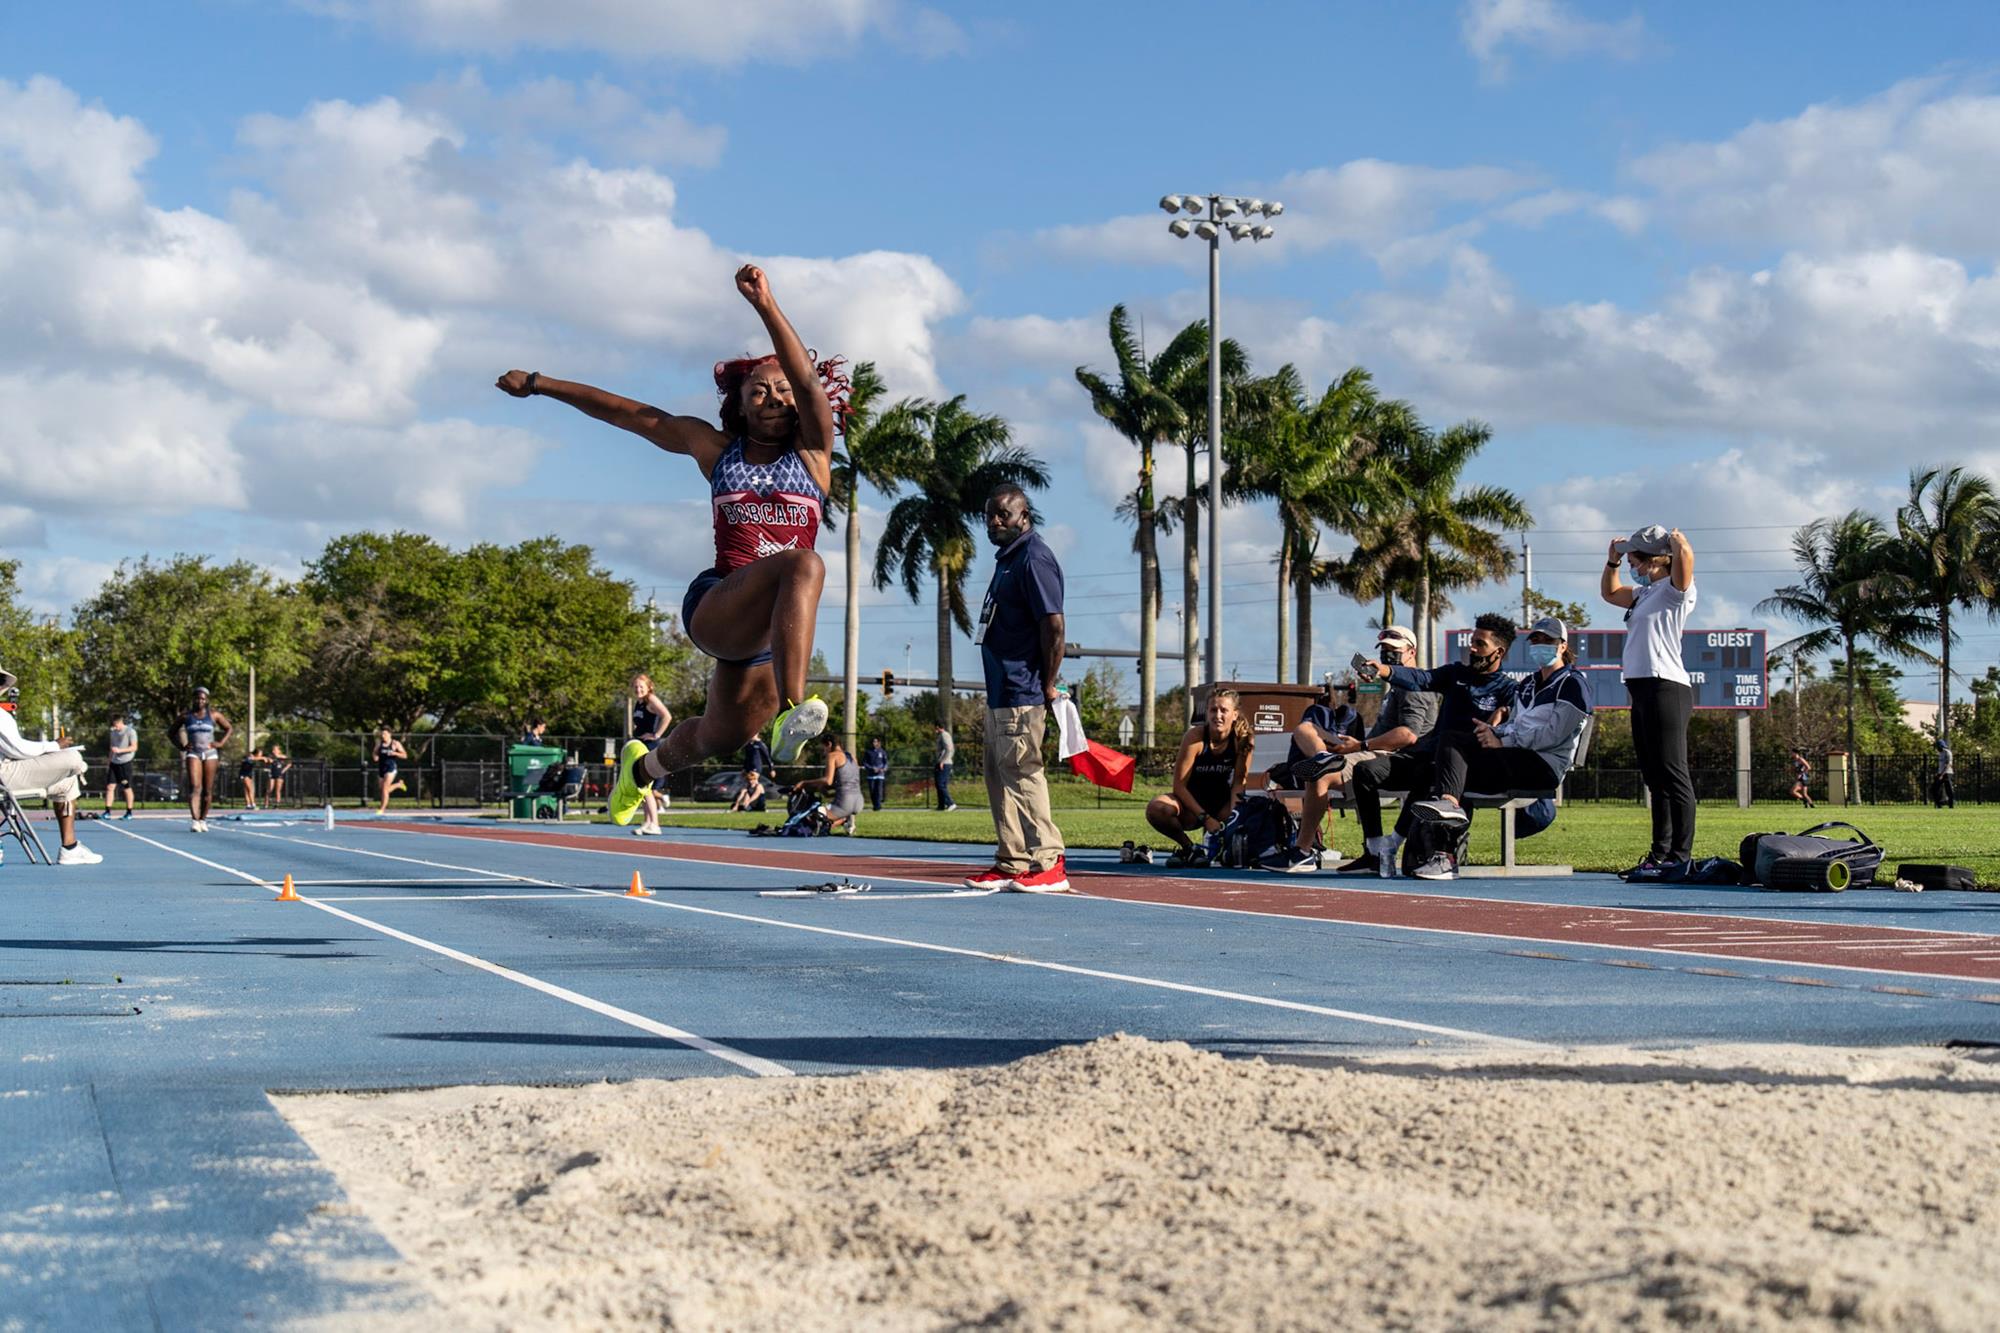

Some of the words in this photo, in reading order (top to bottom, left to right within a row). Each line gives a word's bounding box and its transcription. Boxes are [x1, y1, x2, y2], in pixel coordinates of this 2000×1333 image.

[720, 503, 809, 527] BOBCATS
[1707, 633, 1754, 647] GUEST
[1690, 672, 1705, 683] TR
[1735, 675, 1758, 685] TIME
[1735, 685, 1761, 696] OUTS
[1735, 696, 1758, 706] LEFT
